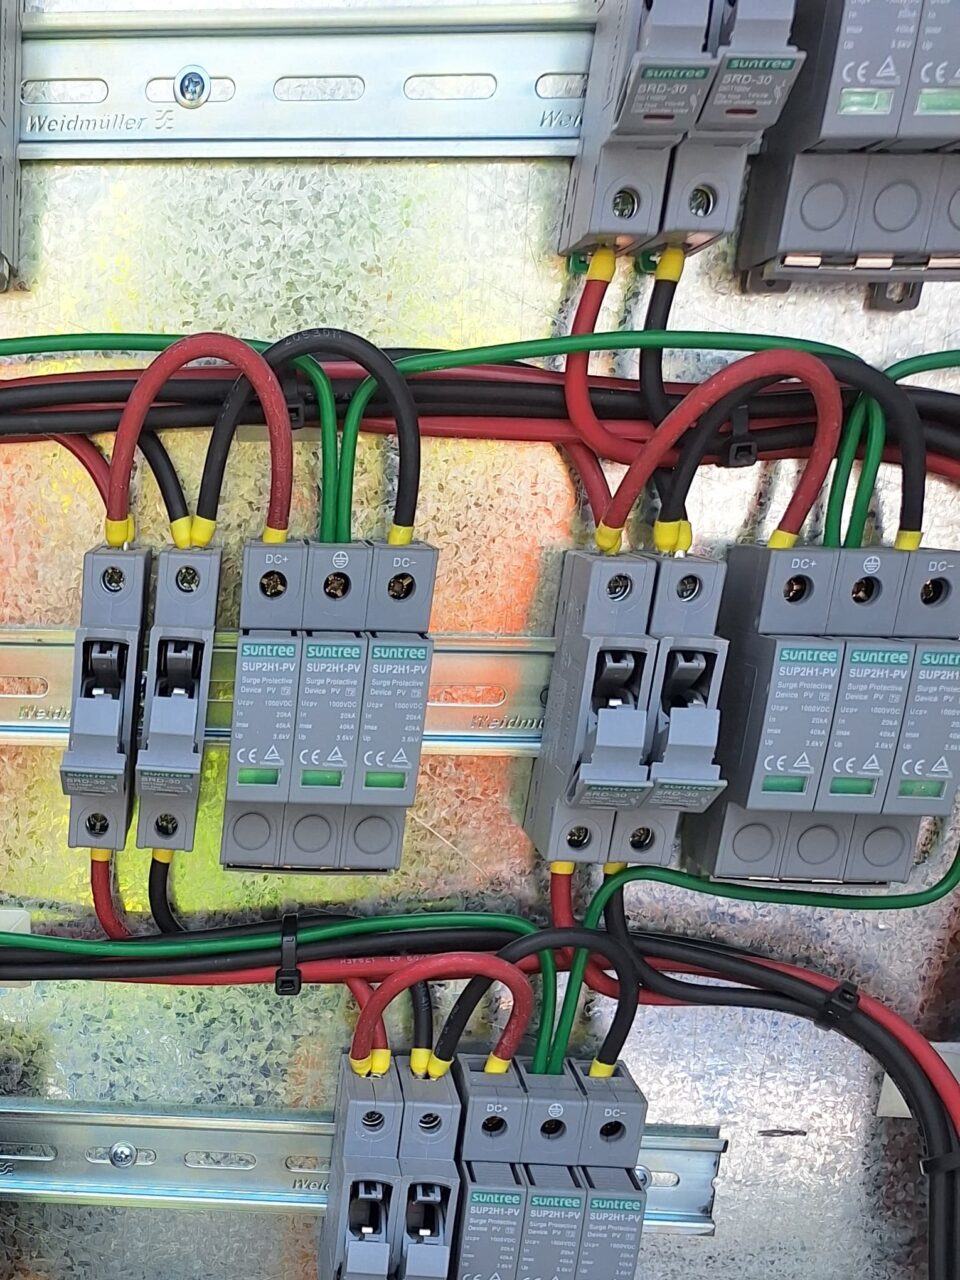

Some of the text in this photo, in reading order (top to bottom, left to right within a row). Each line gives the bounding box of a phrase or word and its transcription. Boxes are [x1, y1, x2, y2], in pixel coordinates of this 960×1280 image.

[729, 59, 791, 69] suntree
[645, 69, 706, 78] suntree
[26, 113, 149, 132] Weidmüller
[265, 554, 289, 564] DC+
[791, 558, 816, 569] DC+
[243, 645, 295, 656] suntree
[307, 646, 360, 658] suntree
[373, 647, 426, 659] suntree
[781, 649, 837, 661] suntree
[851, 651, 908, 663] suntree
[922, 653, 960, 665] suntr
[242, 662, 296, 672] SUP2H1-PV
[306, 663, 361, 673] SUP2H1-PV
[372, 664, 427, 674] SUP2H1-PV
[779, 667, 837, 677] SUP2H1-PV
[849, 669, 907, 679] SUP2H1-PV
[305, 687, 326, 695] Device
[487, 1104, 509, 1113] DC+
[472, 1193, 520, 1204] suntree
[531, 1196, 580, 1207] suntree
[591, 1199, 640, 1210] suntree
[470, 1206, 520, 1216] SUP2H1-PV
[530, 1210, 580, 1219] SUP2H1-PV
[590, 1213, 641, 1222] SUP2H1-PV
